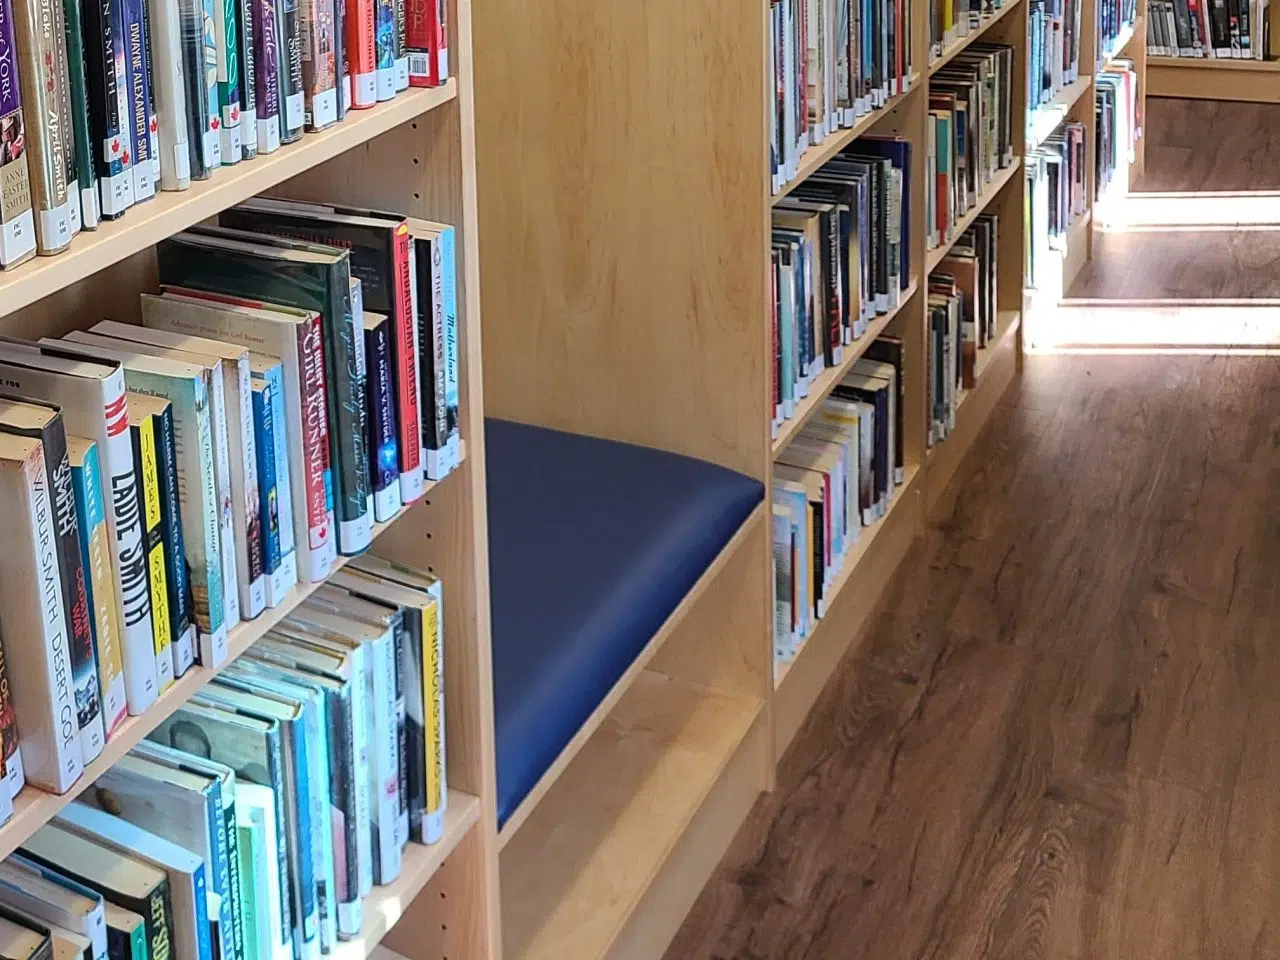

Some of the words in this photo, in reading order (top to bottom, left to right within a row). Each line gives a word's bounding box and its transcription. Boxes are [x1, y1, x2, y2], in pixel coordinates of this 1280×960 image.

[0, 48, 12, 102] YORK
[103, 27, 115, 95] SMITH
[130, 22, 142, 69] DWAYNE
[133, 70, 147, 137] ALEXANDER
[4, 167, 26, 184] ANNE
[5, 195, 30, 212] SMITH
[446, 313, 457, 384] Motherland
[305, 389, 322, 487] RUNNER
[31, 467, 50, 554] WILBUR
[52, 465, 72, 537] SMITH
[42, 550, 60, 624] SMITH
[50, 633, 69, 704] DESERT
